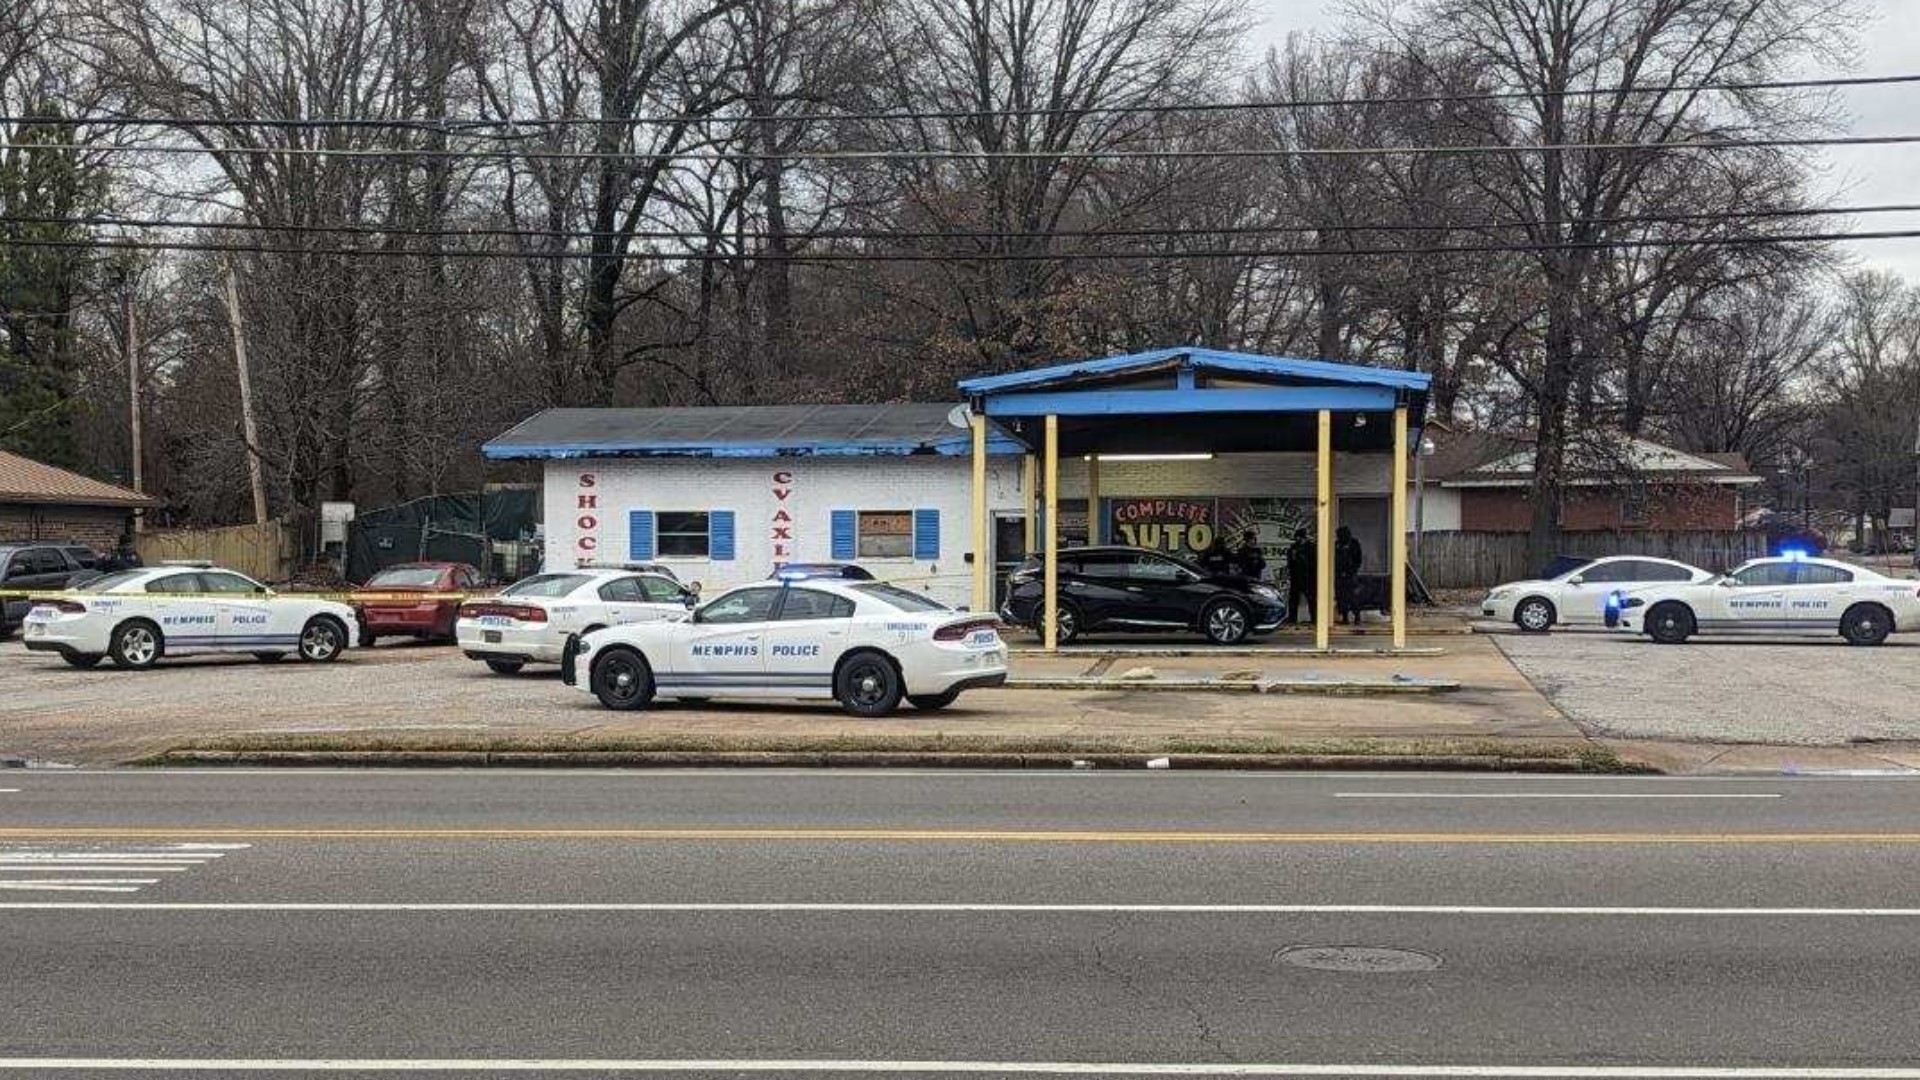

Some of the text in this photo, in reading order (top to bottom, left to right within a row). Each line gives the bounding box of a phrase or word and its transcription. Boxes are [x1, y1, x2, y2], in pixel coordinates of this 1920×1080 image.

[1115, 500, 1209, 523] COMPLETE
[1792, 600, 1829, 609] POLICE
[163, 614, 267, 625] MEMPHIS POLICE
[692, 645, 820, 656] MEMPHIS POLICE
